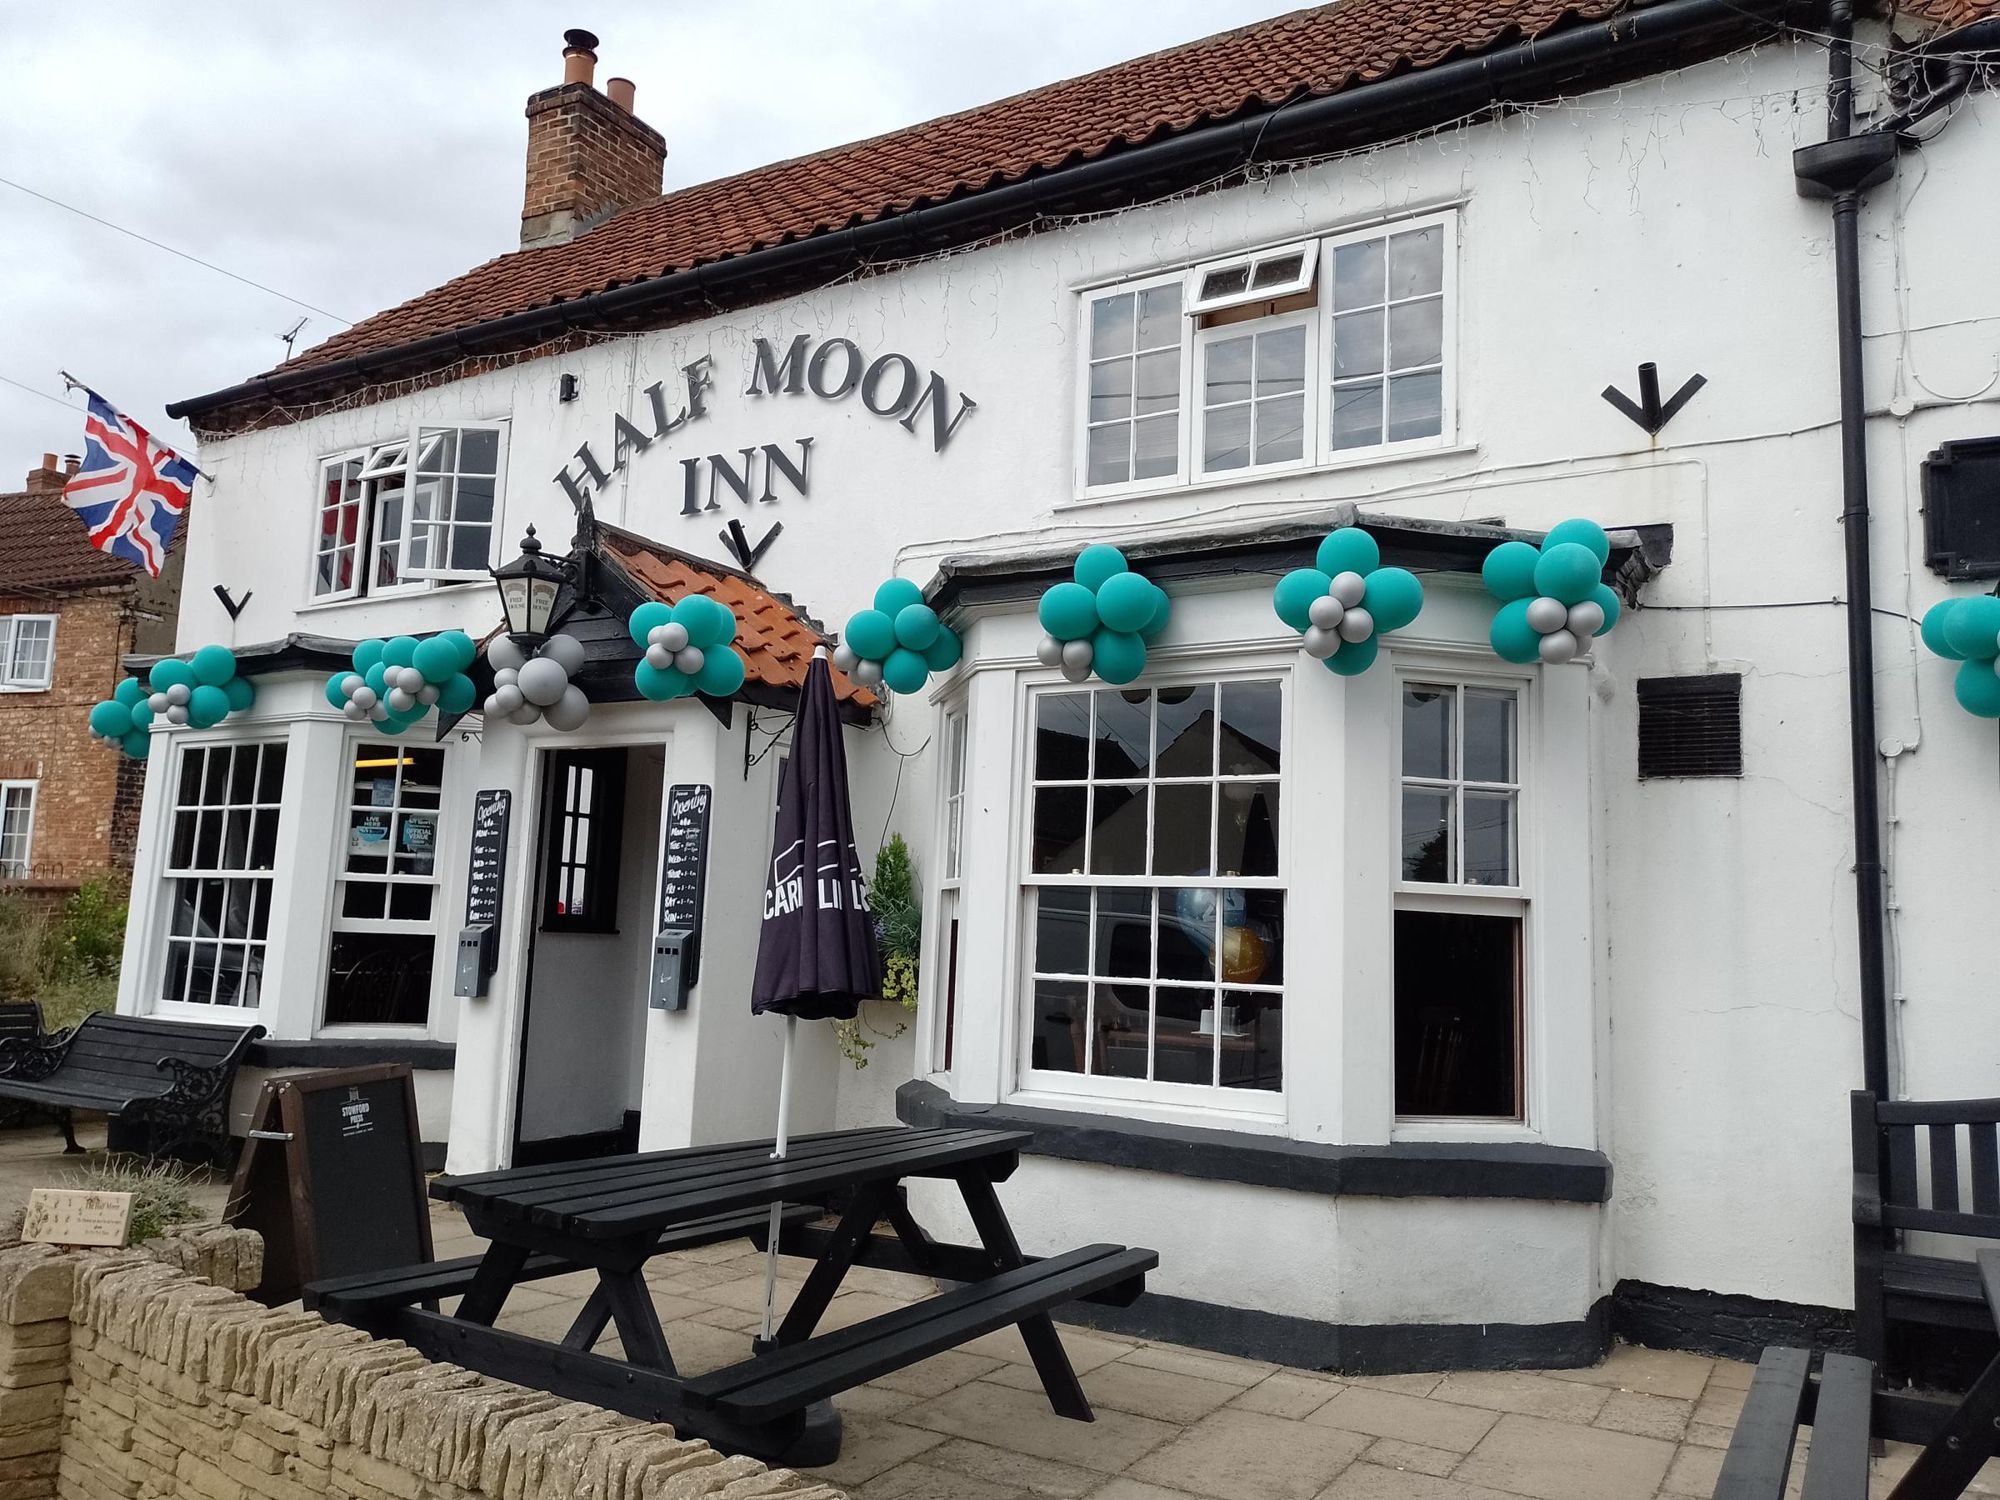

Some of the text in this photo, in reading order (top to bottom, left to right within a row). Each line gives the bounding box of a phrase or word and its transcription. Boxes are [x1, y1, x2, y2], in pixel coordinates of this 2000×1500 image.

[552, 333, 977, 516] HALF MOON
[679, 436, 815, 516] INN
[672, 793, 707, 820] Opening
[341, 1102, 370, 1117] STOWFORD
